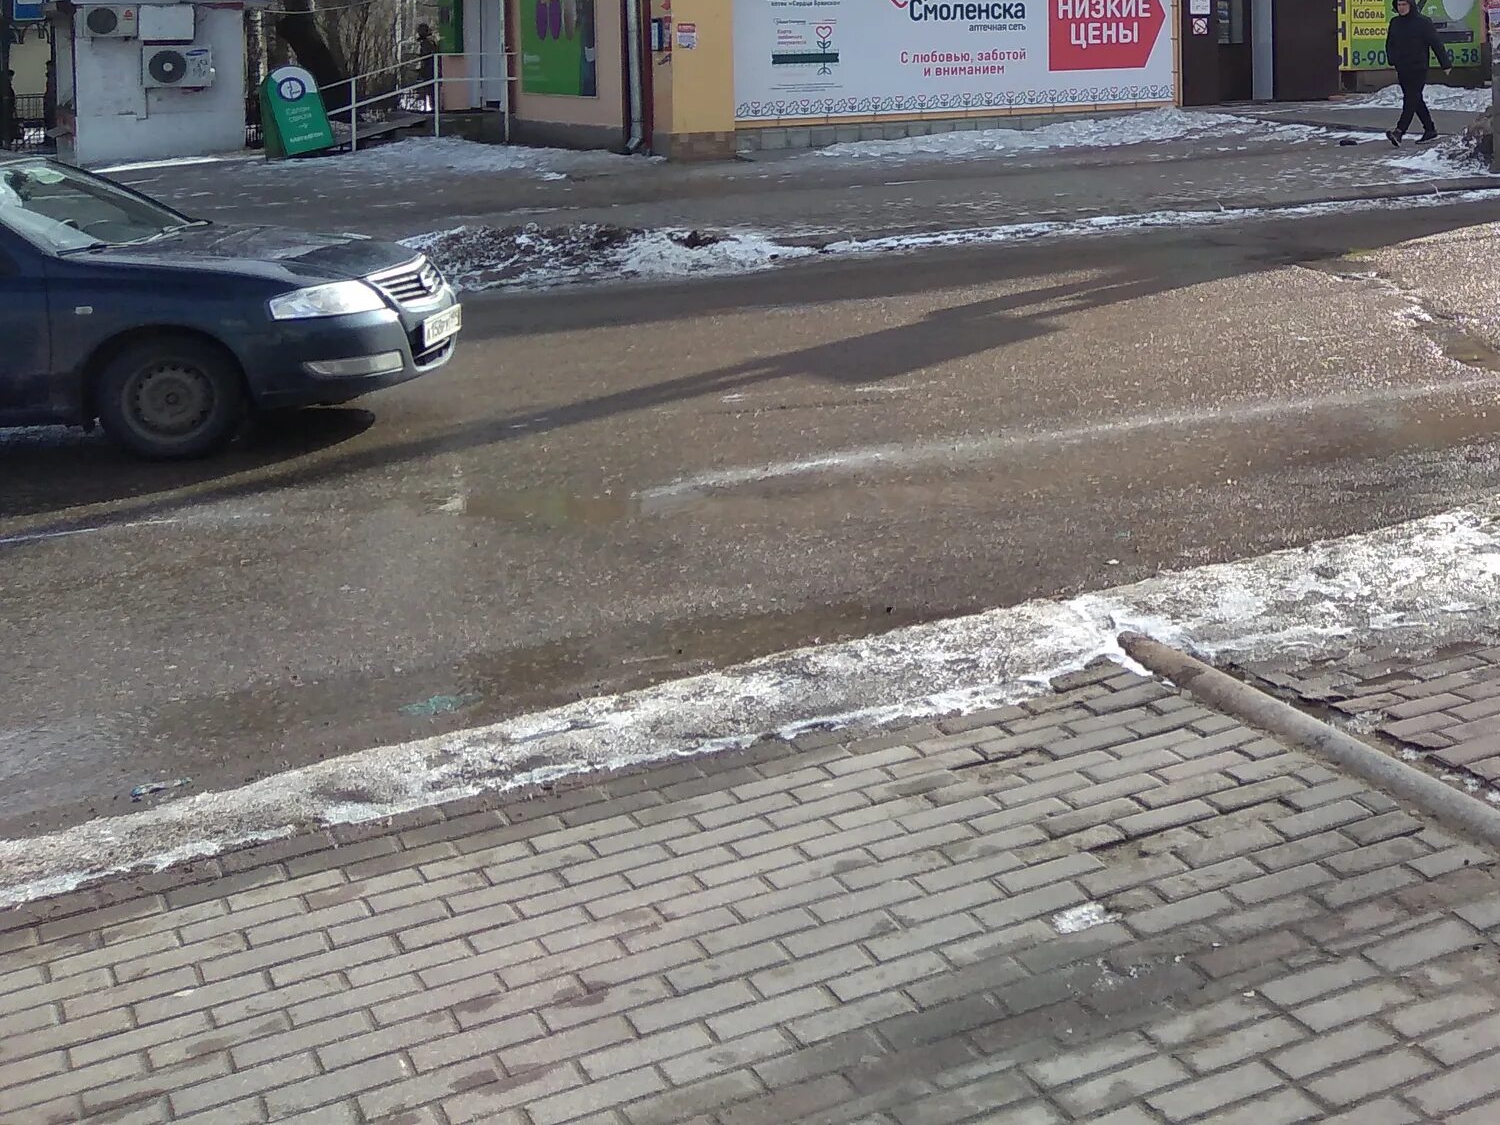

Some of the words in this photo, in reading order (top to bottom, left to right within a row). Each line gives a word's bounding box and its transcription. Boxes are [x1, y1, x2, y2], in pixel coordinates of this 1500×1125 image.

[1353, 8, 1385, 19] Кабель
[968, 23, 1007, 32] аптечная
[1008, 23, 1026, 31] сеть
[1069, 21, 1139, 51] ЦЕНЫ
[900, 51, 909, 63] С
[911, 50, 974, 64] любовью,
[977, 48, 1026, 61] заботой
[923, 66, 931, 77] и
[935, 64, 1005, 76] вниманием
